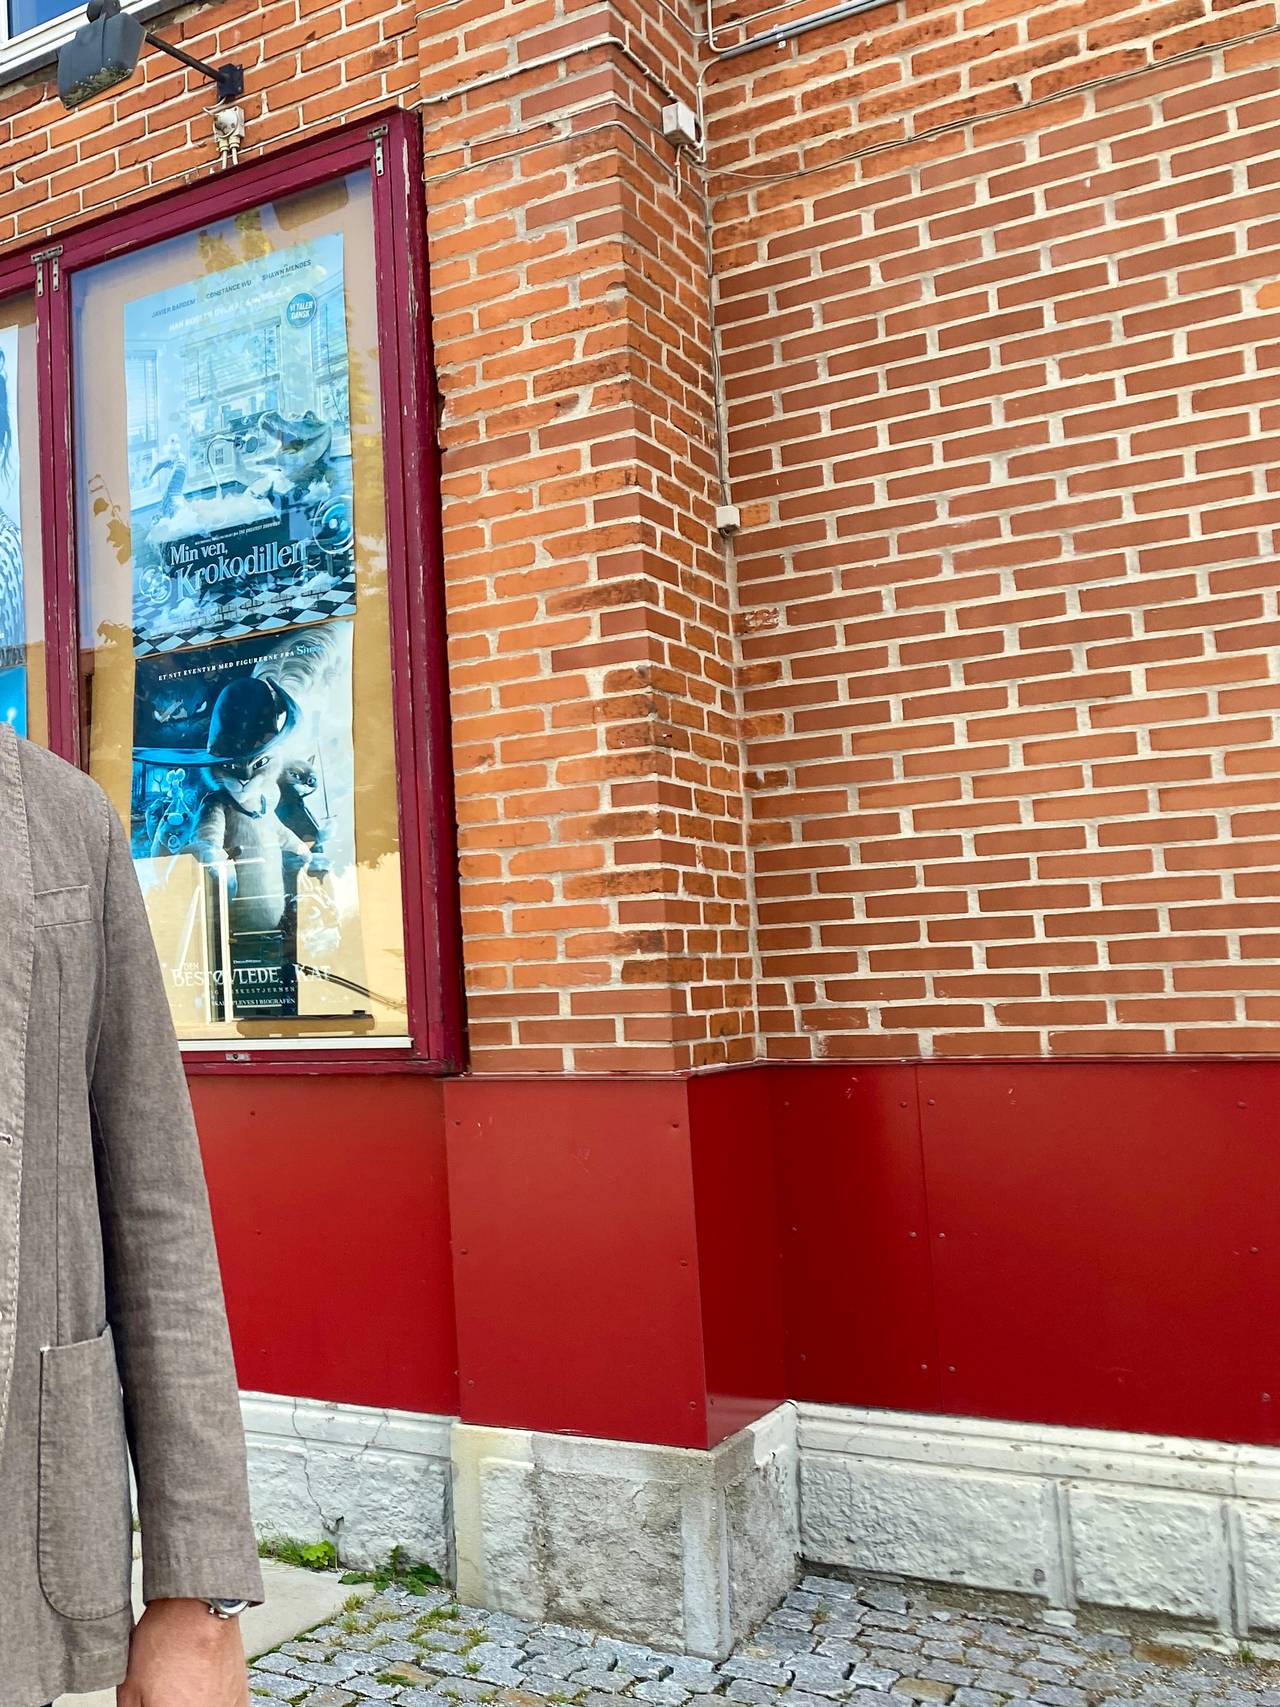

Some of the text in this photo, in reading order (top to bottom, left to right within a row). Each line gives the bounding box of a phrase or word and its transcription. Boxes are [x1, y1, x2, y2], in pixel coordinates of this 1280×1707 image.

[206, 282, 241, 300] CONSTANCE
[241, 279, 252, 289] WU
[262, 268, 286, 281] SHAWN
[285, 259, 312, 273] MENDES
[291, 310, 310, 320] DANSK
[296, 300, 313, 310] TALER
[170, 542, 228, 565] Min ven,
[176, 541, 308, 600] Krokodillen
[168, 671, 181, 680] NYT
[183, 665, 217, 677] EVENTYR
[218, 662, 234, 671] MED
[235, 653, 279, 667] FIGURERNE
[280, 650, 295, 658] FRA
